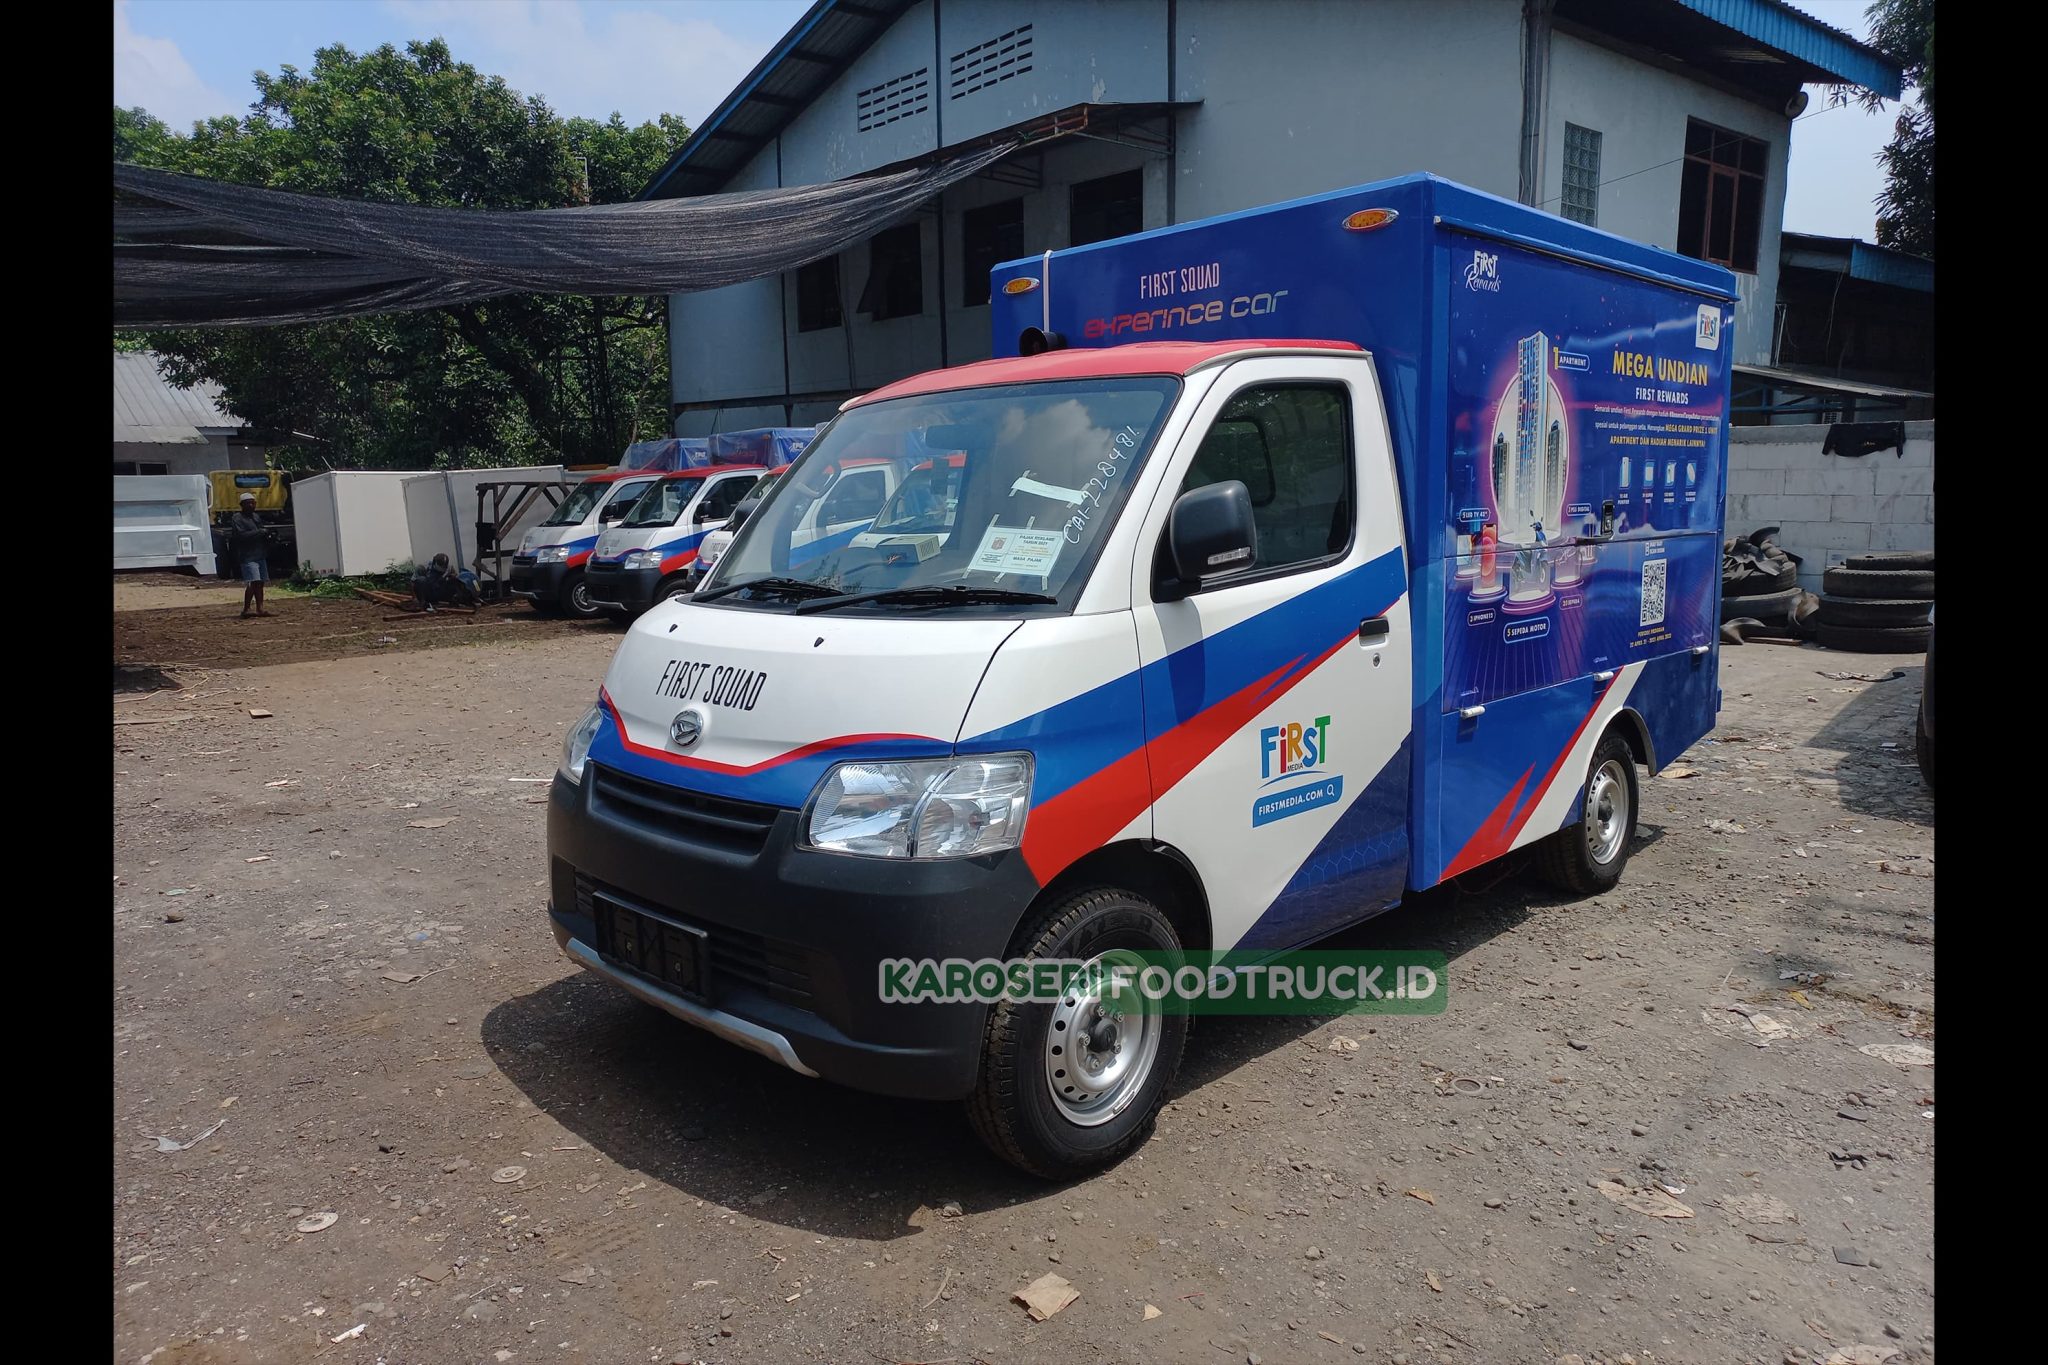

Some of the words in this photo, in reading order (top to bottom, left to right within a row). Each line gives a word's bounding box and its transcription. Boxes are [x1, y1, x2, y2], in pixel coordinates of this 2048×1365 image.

[1140, 270, 1177, 300] FIRST
[1181, 262, 1220, 293] SQUAD
[1464, 263, 1502, 293] Rewards
[1230, 289, 1289, 319] car
[1612, 350, 1654, 379] MEGA
[1658, 357, 1708, 387] UNDIAN
[1635, 387, 1655, 401] FIRST
[1656, 389, 1689, 405] REWARDS
[1511, 626, 1529, 636] SEPEDA
[1530, 623, 1546, 633] MOTOR
[656, 659, 711, 700] FIRST
[702, 665, 767, 711] SQUAD
[1287, 762, 1304, 773] MEDIA
[1258, 788, 1324, 816] FIRSTMEDIA.COM
